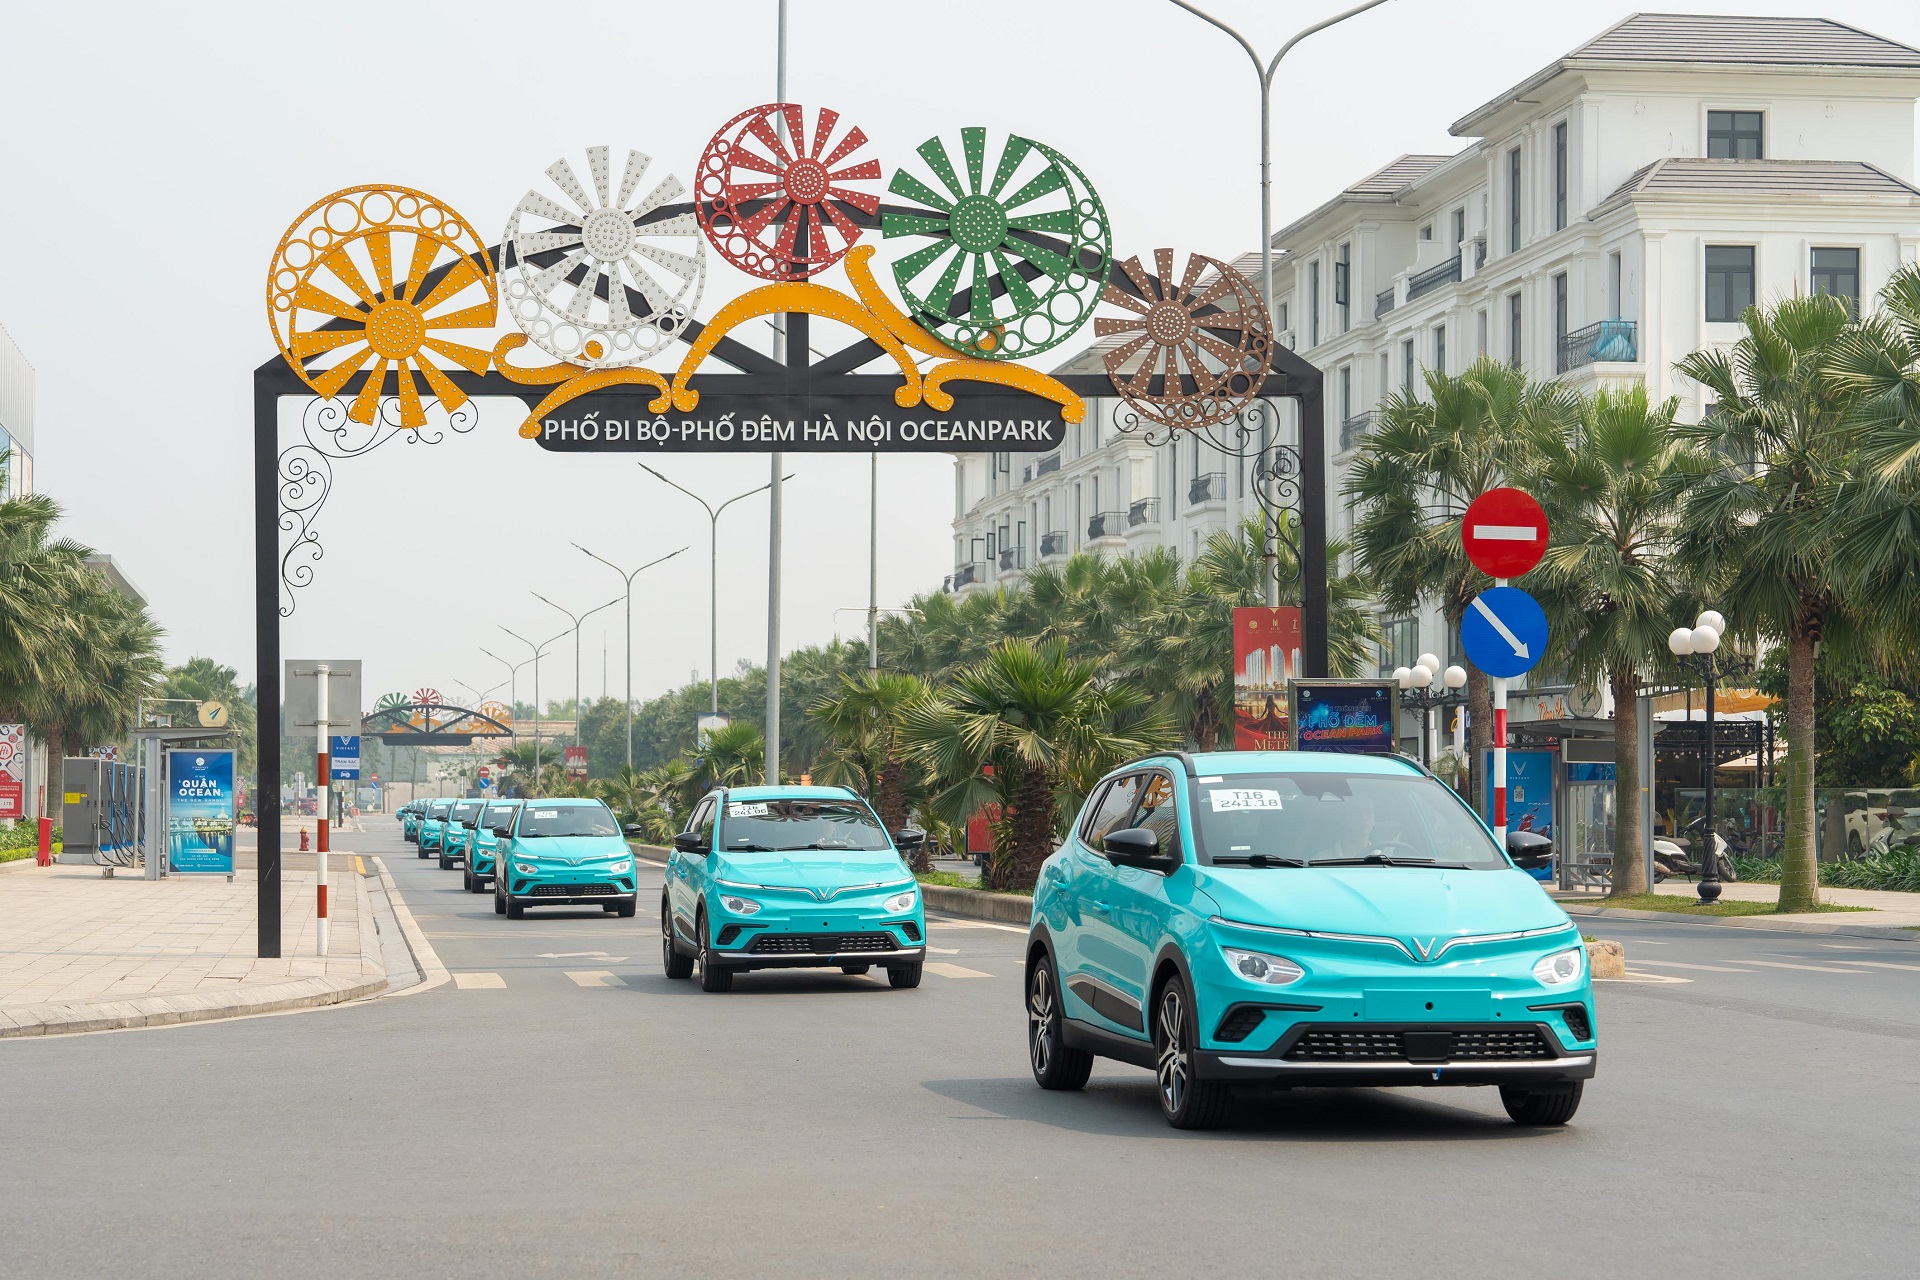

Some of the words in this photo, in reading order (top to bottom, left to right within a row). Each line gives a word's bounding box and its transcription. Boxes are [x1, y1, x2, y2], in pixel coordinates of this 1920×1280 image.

[544, 411, 600, 441] PHỐ
[604, 419, 630, 441] ĐI
[637, 411, 736, 446] BỘ-PHỐ
[741, 414, 795, 441] ĐÊM
[803, 413, 839, 441] HÀ
[847, 414, 891, 446] NỘI
[899, 419, 1053, 441] OCEANPARK
[1308, 711, 1340, 728] PHỐ
[1343, 711, 1377, 728] ĐÊM
[1265, 730, 1288, 740] THE
[1303, 727, 1347, 740] OCEAN
[1348, 725, 1383, 737] PARK
[1232, 791, 1264, 800] T16
[1220, 799, 1278, 808] 241.18
